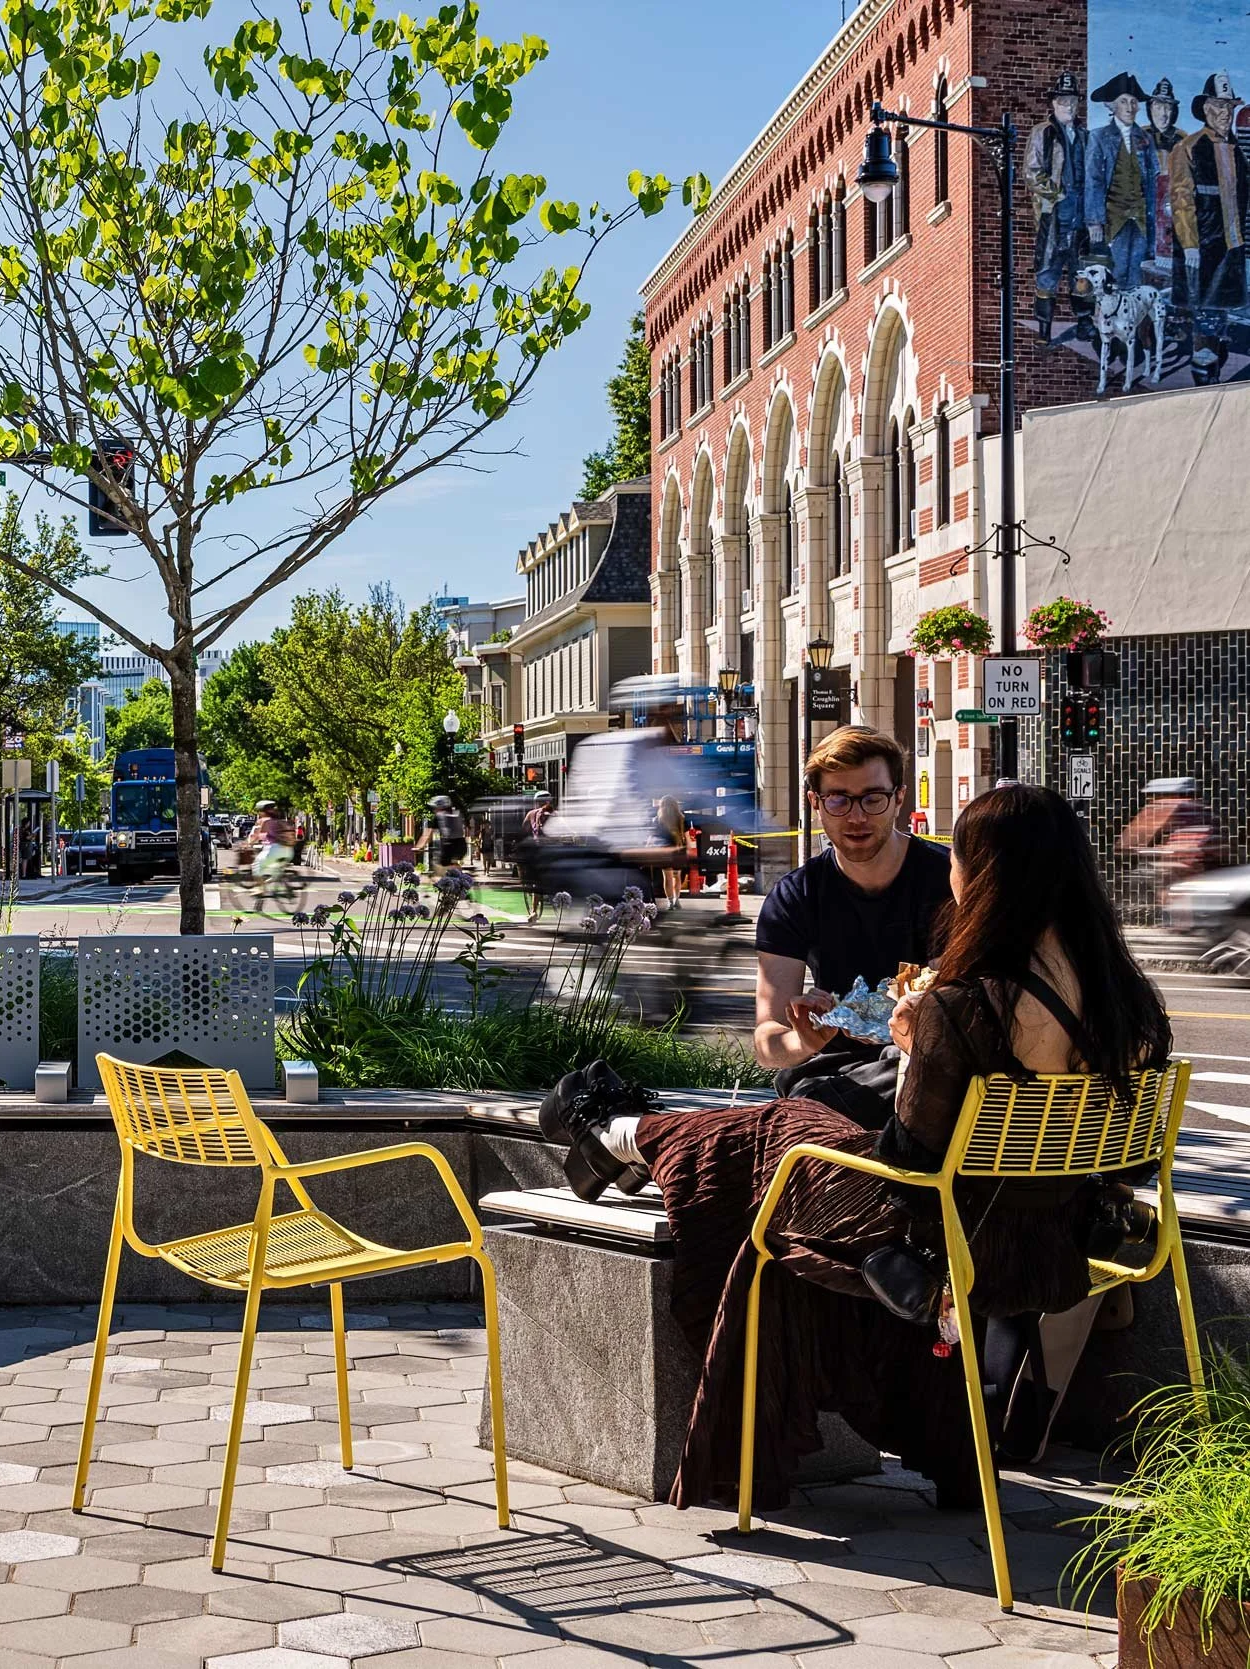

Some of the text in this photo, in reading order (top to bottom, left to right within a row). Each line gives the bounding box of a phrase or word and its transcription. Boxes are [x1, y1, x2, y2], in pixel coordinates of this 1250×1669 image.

[1001, 665, 1023, 677] NO
[996, 681, 1029, 693] TURN
[812, 695, 840, 703] Coughlin
[988, 697, 1036, 708] ON RED
[812, 702, 835, 710] Square
[716, 745, 736, 753] Geni
[706, 846, 727, 856] 4x4
